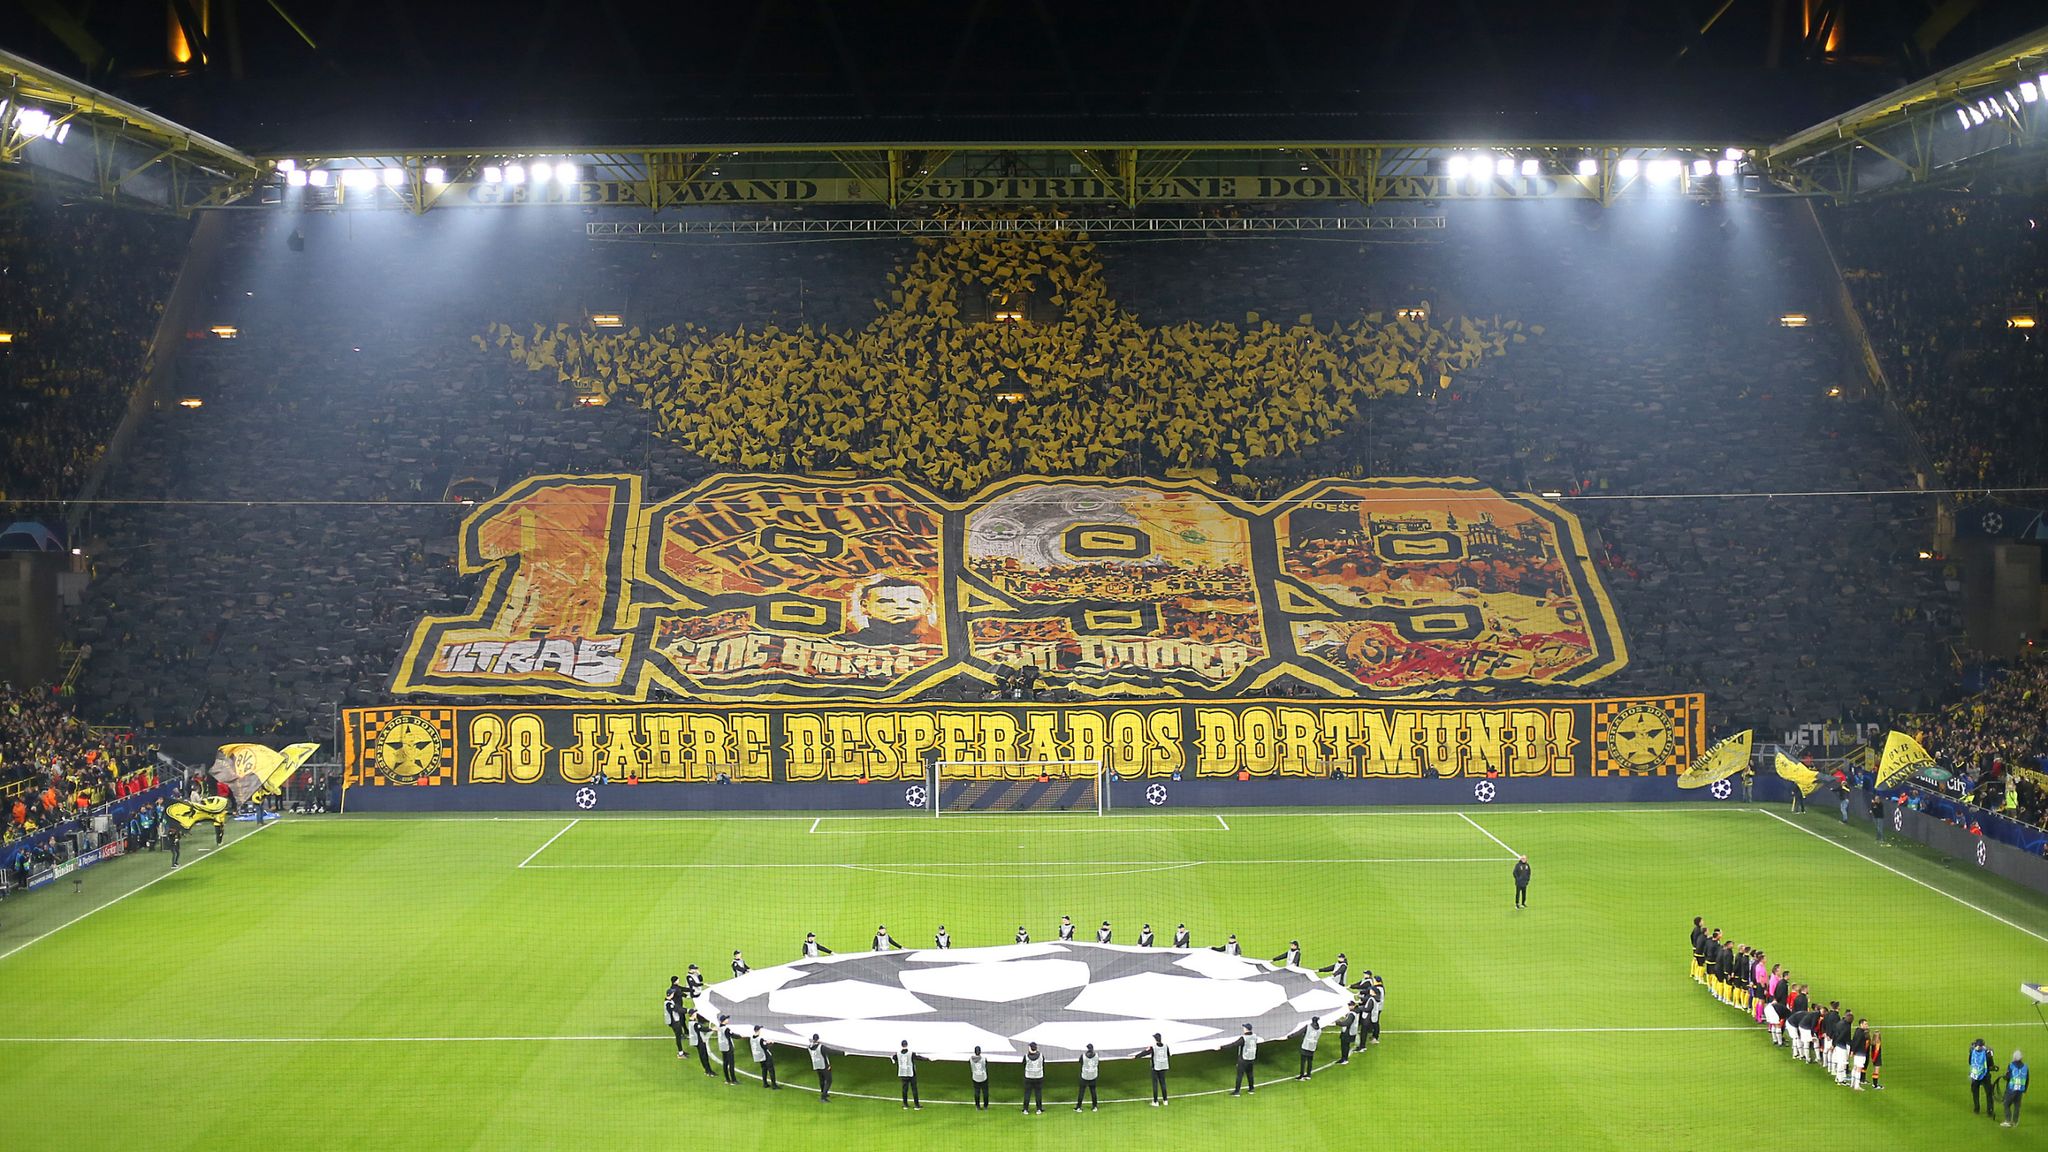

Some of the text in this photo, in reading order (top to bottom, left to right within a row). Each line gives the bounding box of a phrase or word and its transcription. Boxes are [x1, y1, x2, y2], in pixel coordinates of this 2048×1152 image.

[468, 180, 818, 203] GELBE WAND
[900, 177, 1558, 199] SÜDTRIBÜNE DORTMUND
[440, 637, 624, 684] ULTRAS
[469, 706, 1580, 783] 20 JAHRE DESPERADOS DORTMUND!
[1888, 743, 1909, 761] BVB
